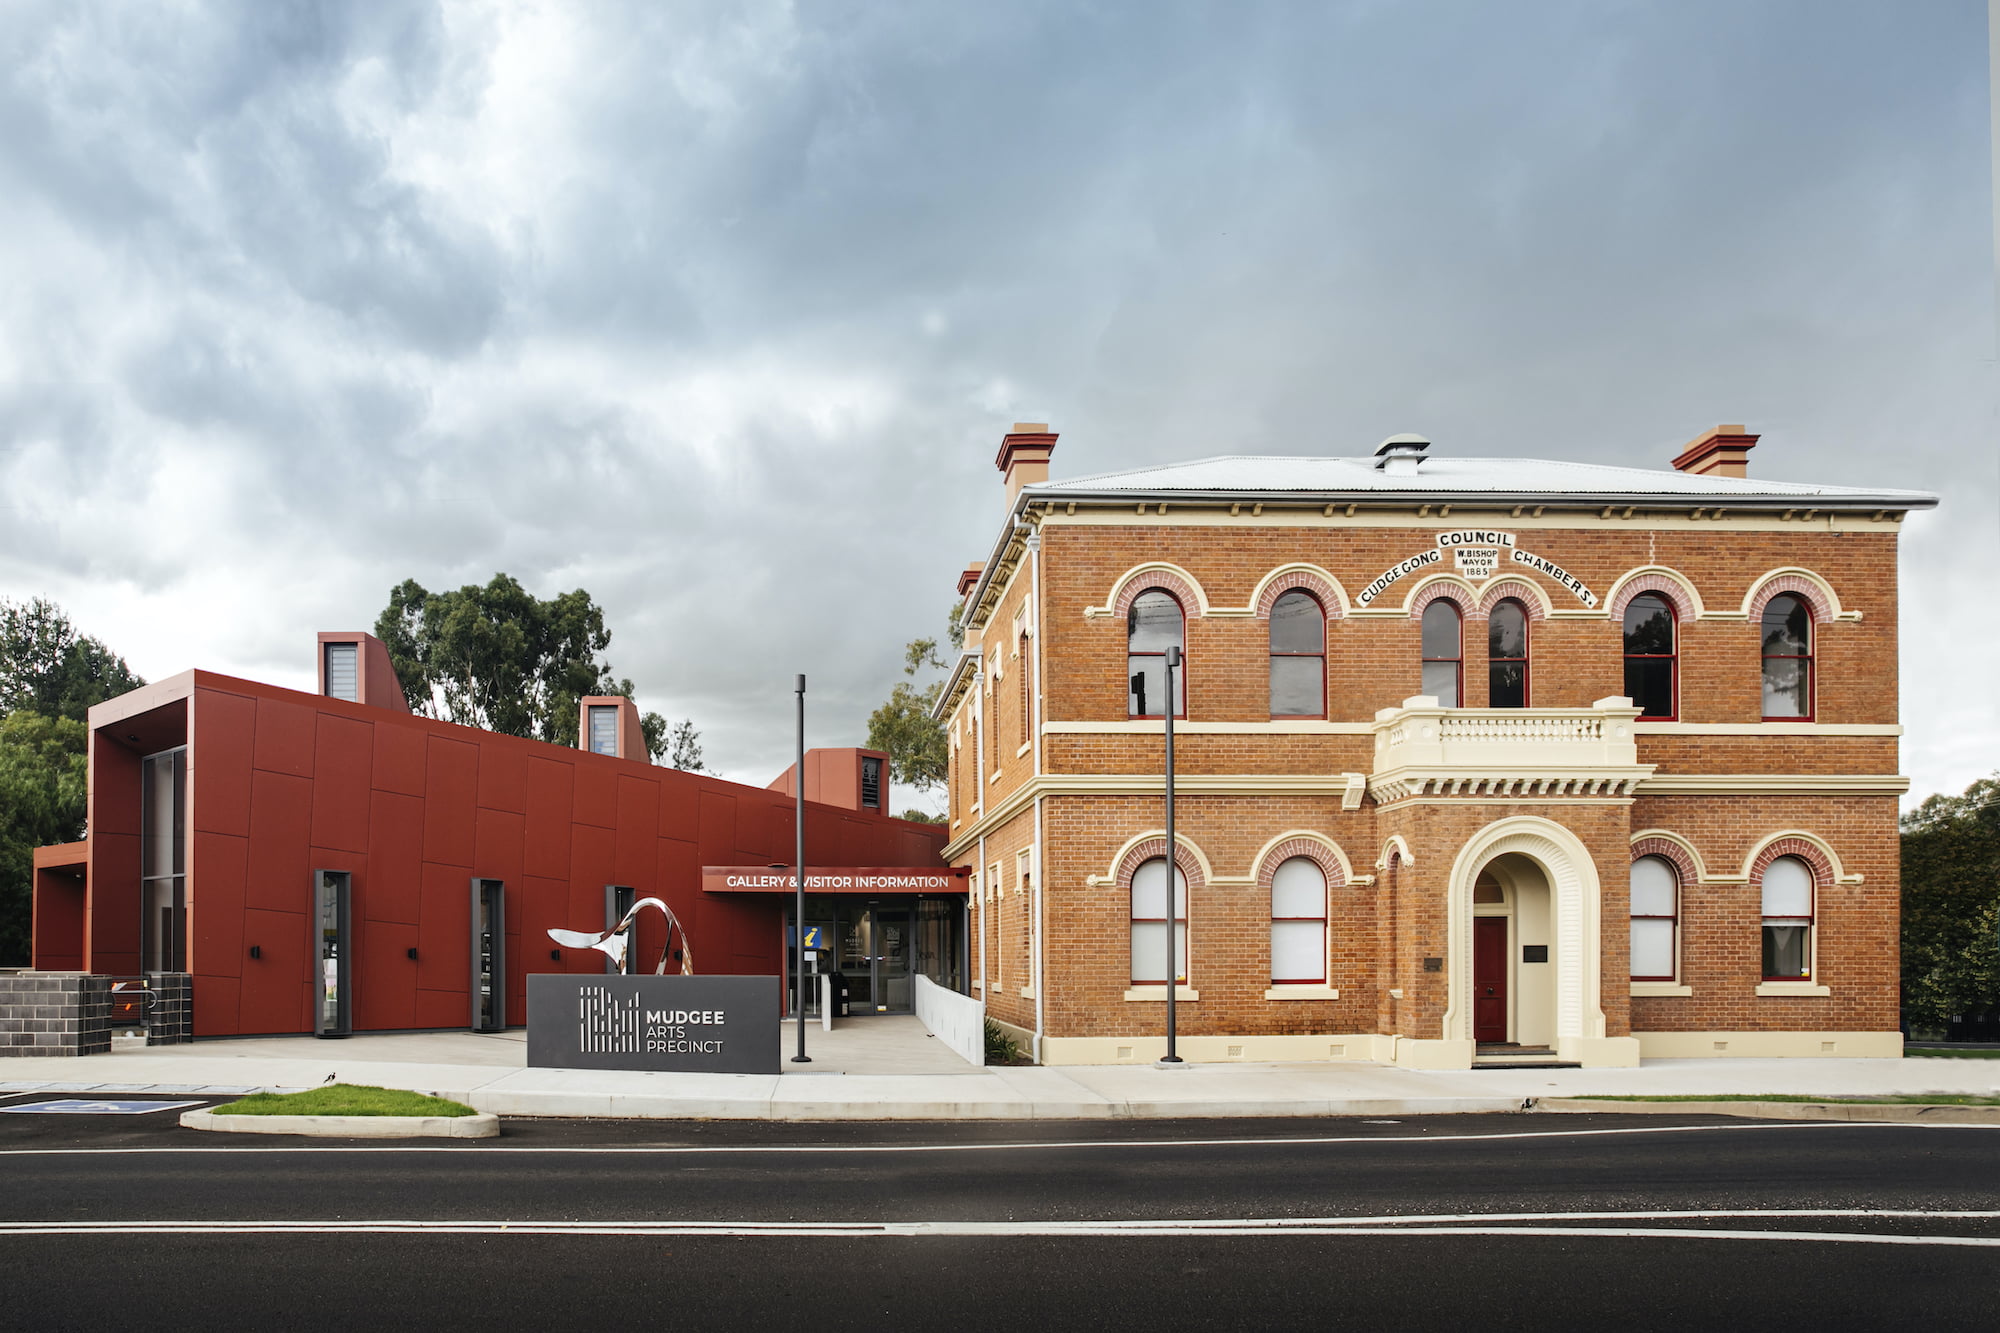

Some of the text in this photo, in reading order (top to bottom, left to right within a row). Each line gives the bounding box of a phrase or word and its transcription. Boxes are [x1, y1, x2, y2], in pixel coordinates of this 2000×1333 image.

[1361, 551, 1439, 602] CUDGEGONG
[1440, 531, 1511, 546] COUNCIL
[1462, 558, 1493, 566] MAYOR
[1466, 567, 1488, 576] 1885
[726, 876, 786, 888] GALLERY
[788, 876, 798, 888] &
[855, 876, 949, 888] INFORMATION
[646, 1010, 725, 1025] MUDGEE
[646, 1026, 686, 1039] ARTS
[647, 1040, 724, 1053] PRECINCT
